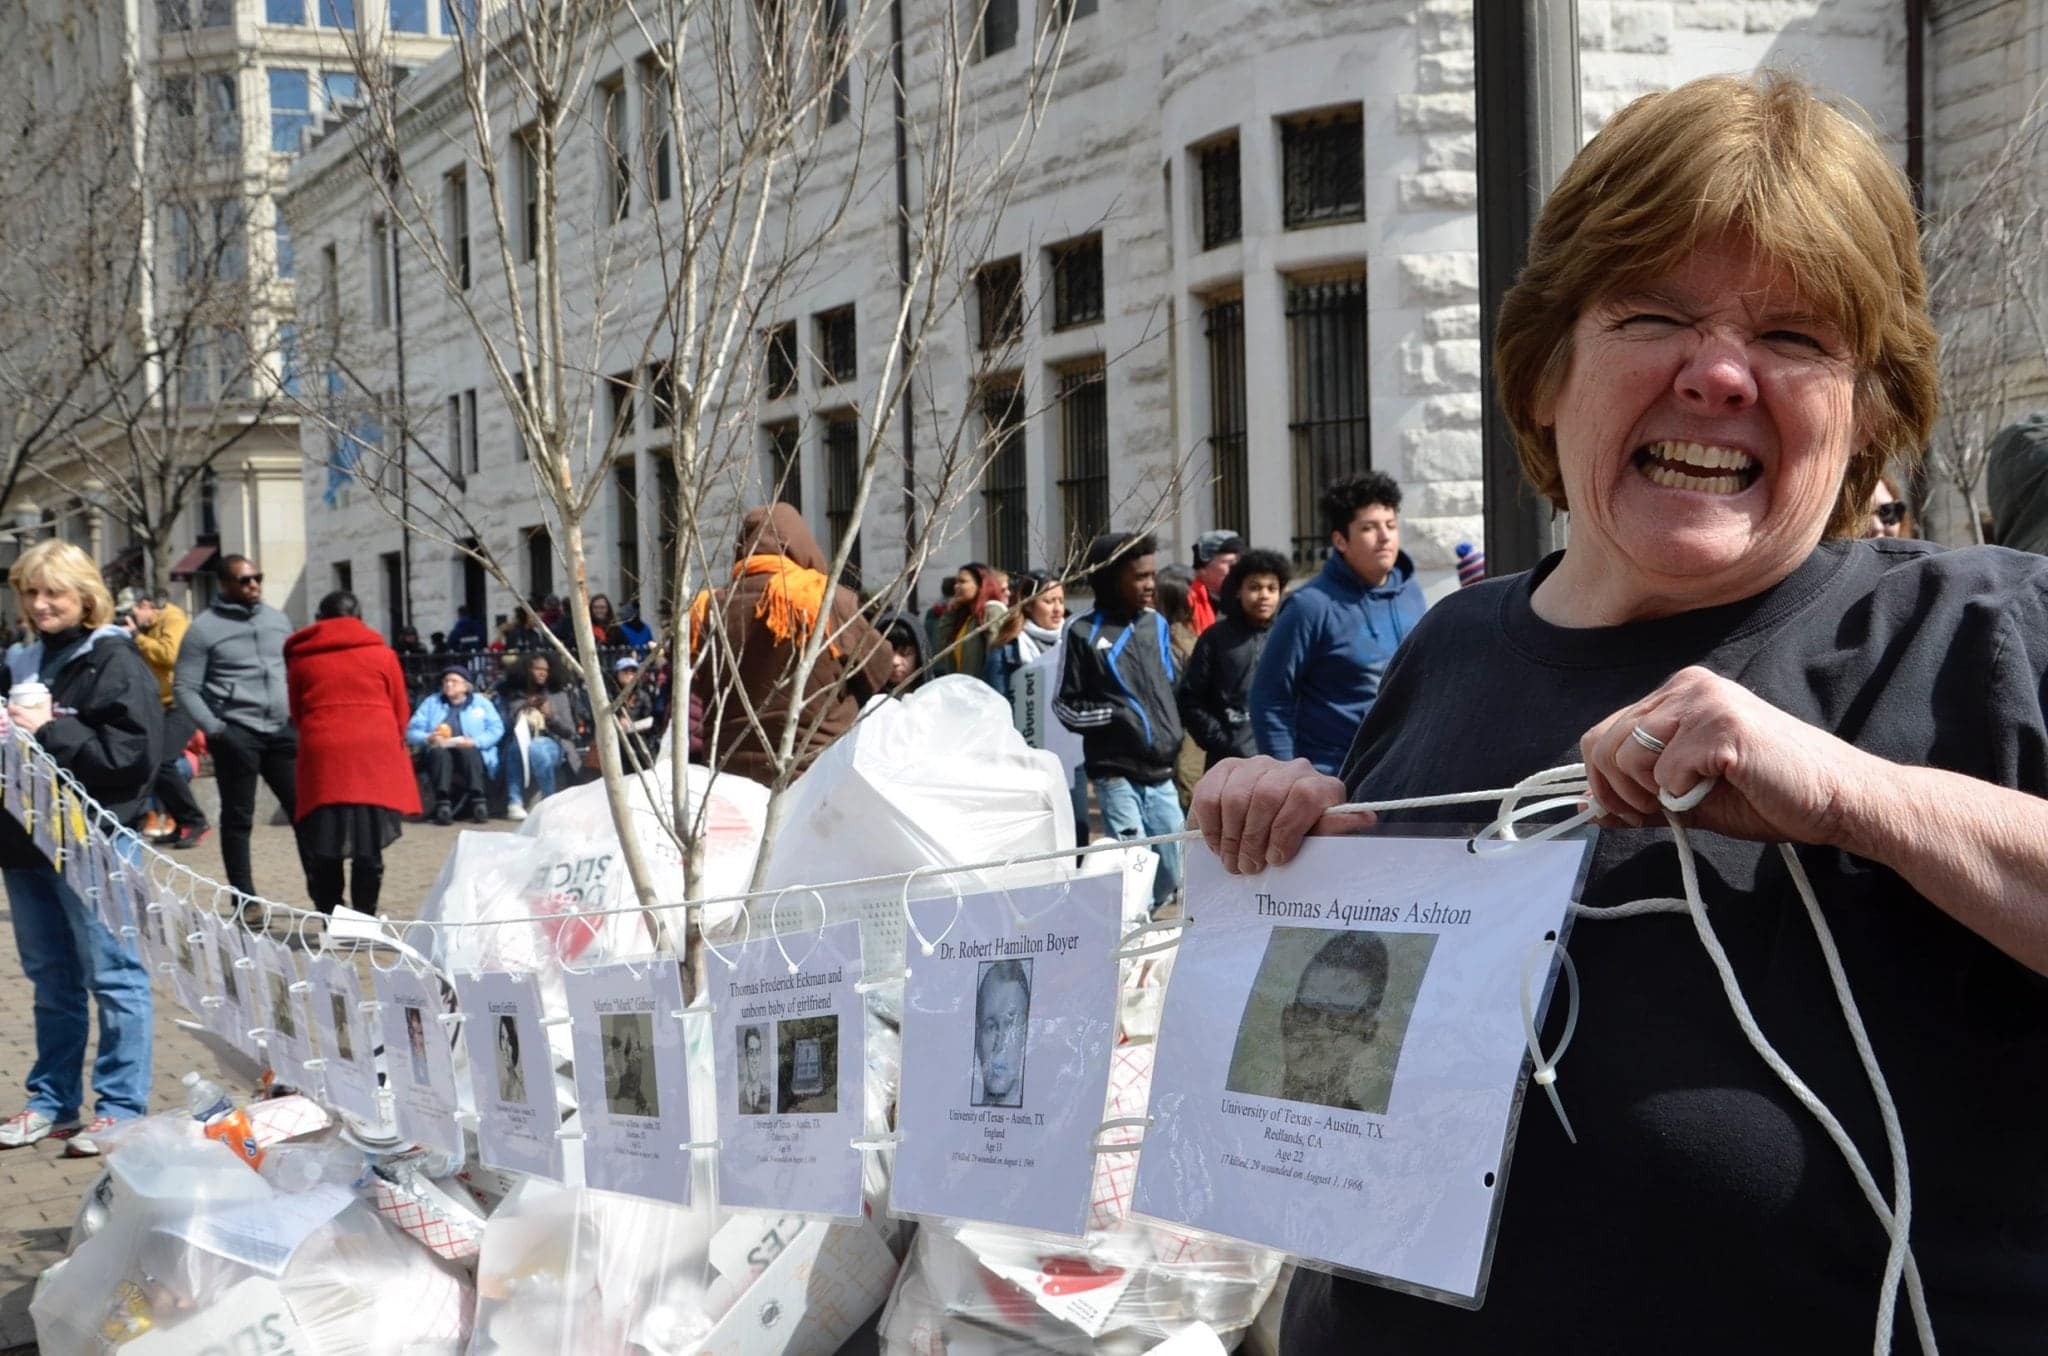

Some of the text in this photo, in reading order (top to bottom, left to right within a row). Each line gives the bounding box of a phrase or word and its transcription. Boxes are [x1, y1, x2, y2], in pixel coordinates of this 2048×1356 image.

[1255, 893, 1472, 926] Thomas Aquinas Ashton
[940, 933, 1080, 960] Dr. Robert Hamilton Boyer
[729, 966, 842, 997] Thomas Frederick Eckman and
[741, 992, 832, 1018] unborn baby of girlfriend
[985, 1110, 1004, 1123] Texas
[1034, 1113, 1045, 1125] TX
[1221, 1098, 1268, 1122] University
[1270, 1107, 1283, 1121] of
[1283, 1109, 1313, 1127] Texas
[1323, 1116, 1362, 1136] Austin,
[1367, 1121, 1384, 1139] TX
[1264, 1126, 1322, 1149] Redlands, CA
[1275, 1148, 1304, 1163] Age 22
[1220, 1153, 1229, 1164] 17
[1250, 1159, 1259, 1170] 29
[1260, 1163, 1292, 1178] wounded
[1292, 1170, 1303, 1179] on
[1304, 1171, 1331, 1186] August
[1342, 1177, 1363, 1191] 1966
